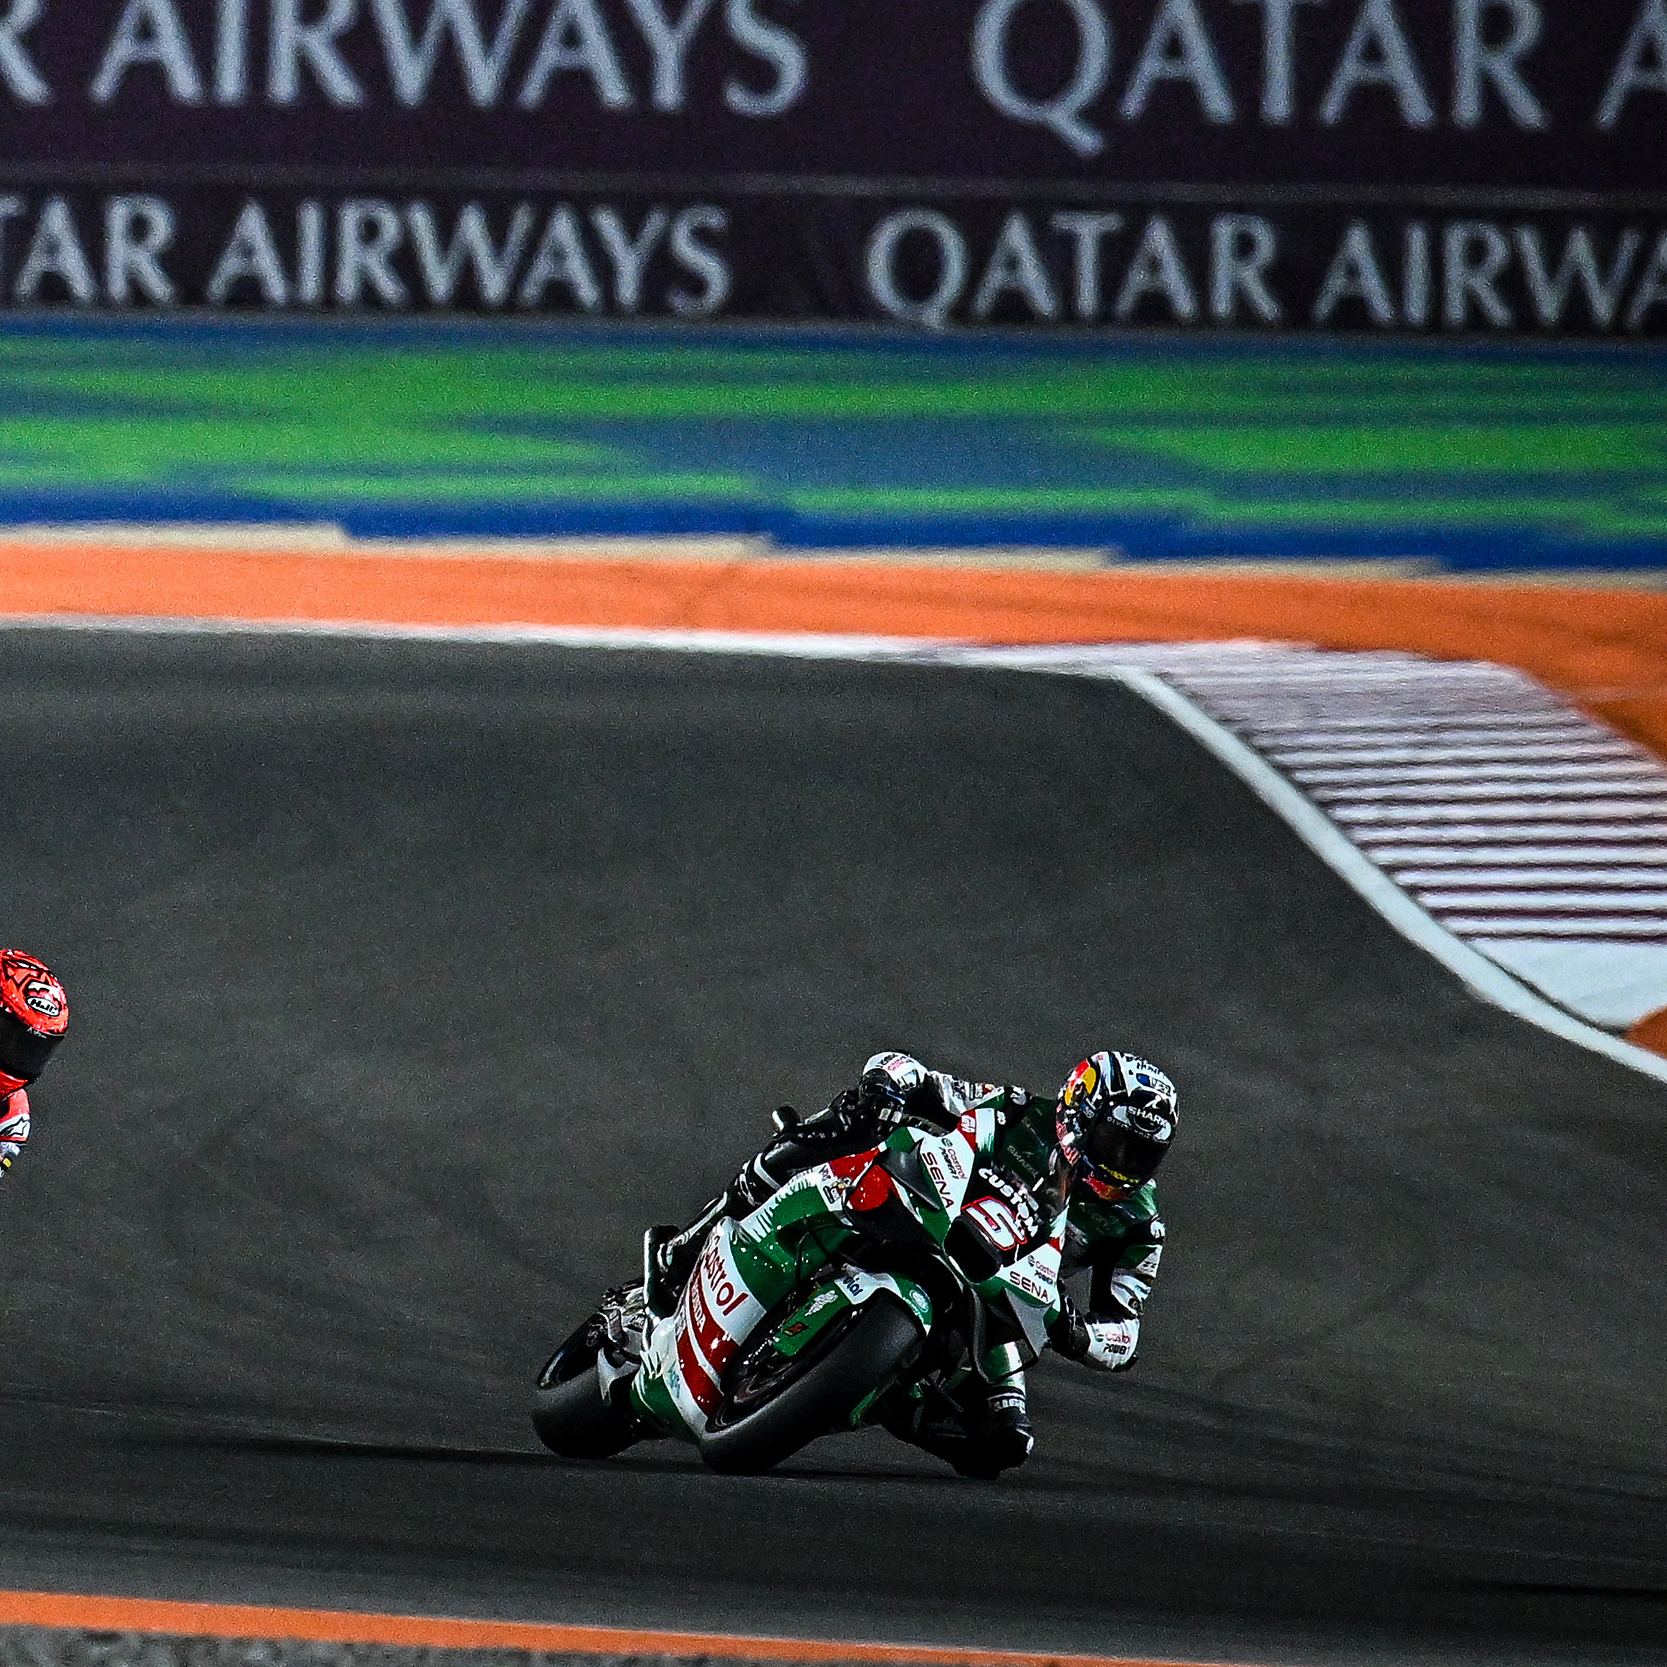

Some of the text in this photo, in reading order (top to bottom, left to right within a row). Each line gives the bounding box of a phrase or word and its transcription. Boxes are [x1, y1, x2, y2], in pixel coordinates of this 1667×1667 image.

[208, 199, 731, 316] AIRWAYS
[864, 208, 1281, 329] QATAR
[29, 998, 58, 1015] HJC
[1127, 1106, 1168, 1129] SHARK
[922, 1152, 955, 1208] SENA
[1009, 1270, 1049, 1302] SENA
